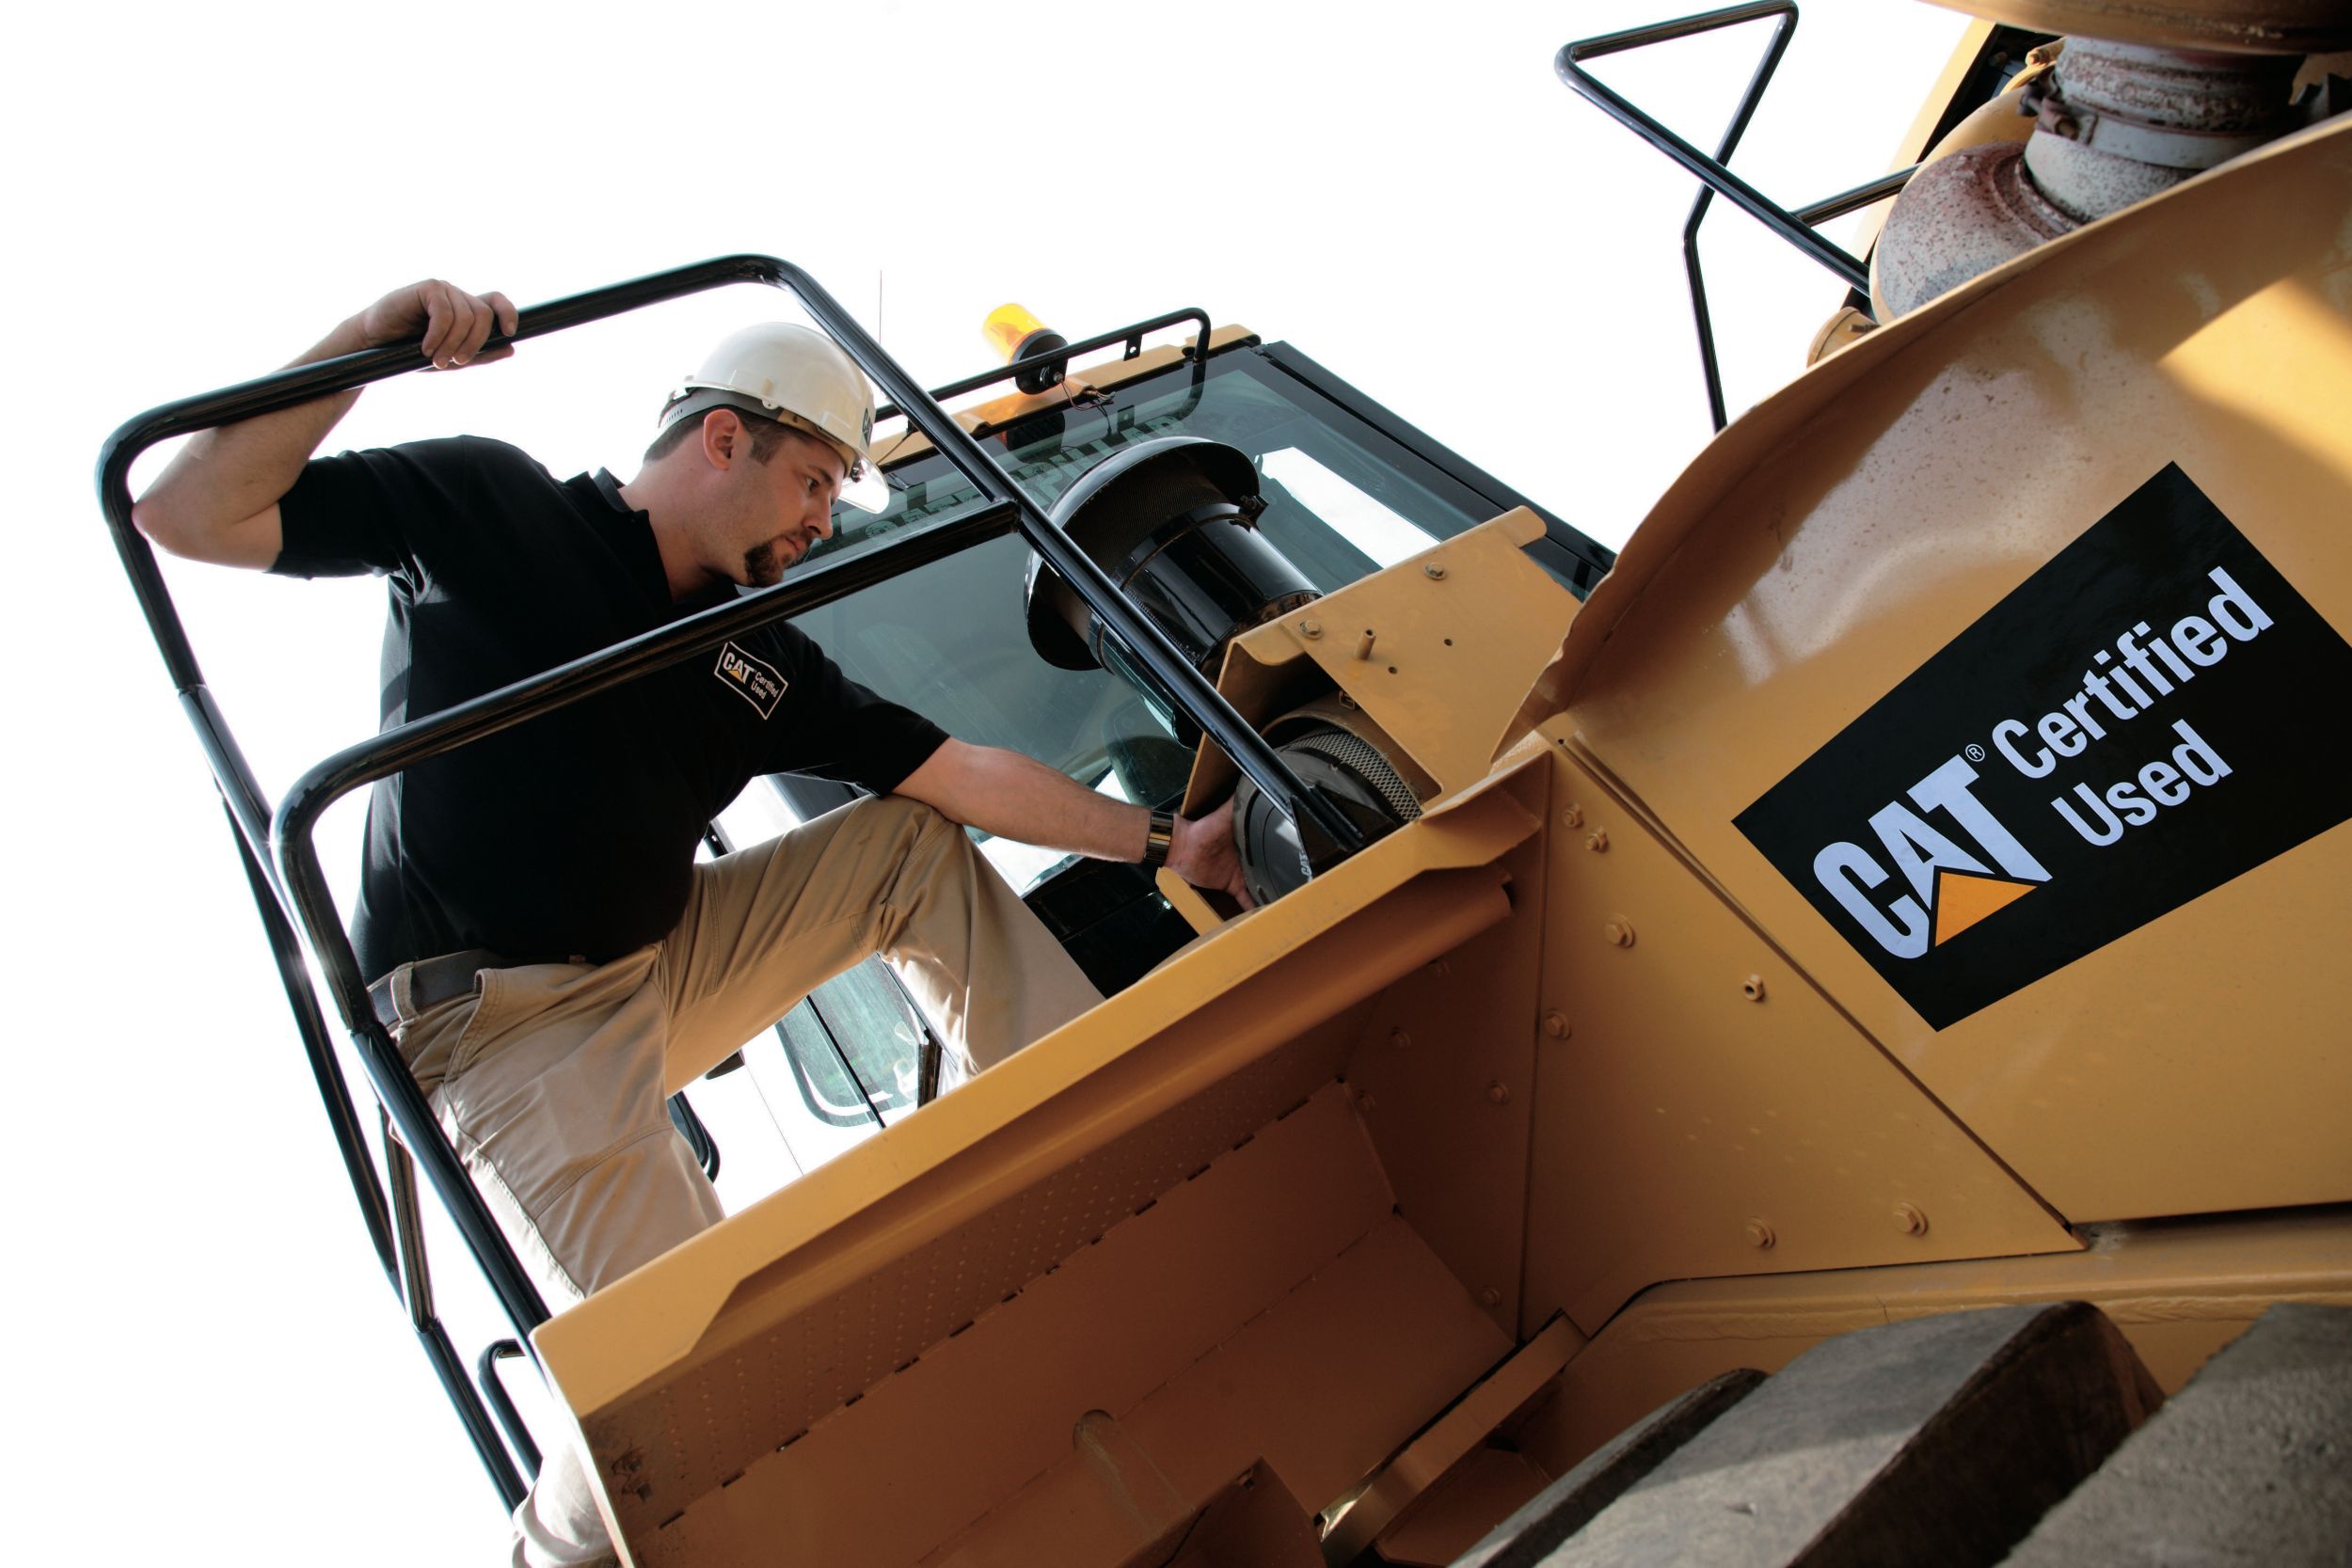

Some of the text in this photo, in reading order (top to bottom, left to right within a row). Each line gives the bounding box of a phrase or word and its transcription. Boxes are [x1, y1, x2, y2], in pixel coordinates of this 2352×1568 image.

[723, 652, 755, 684] CAT
[1992, 565, 2275, 779] Certified
[751, 681, 768, 699] Used
[755, 672, 779, 697] Certified
[2050, 719, 2233, 847] Used
